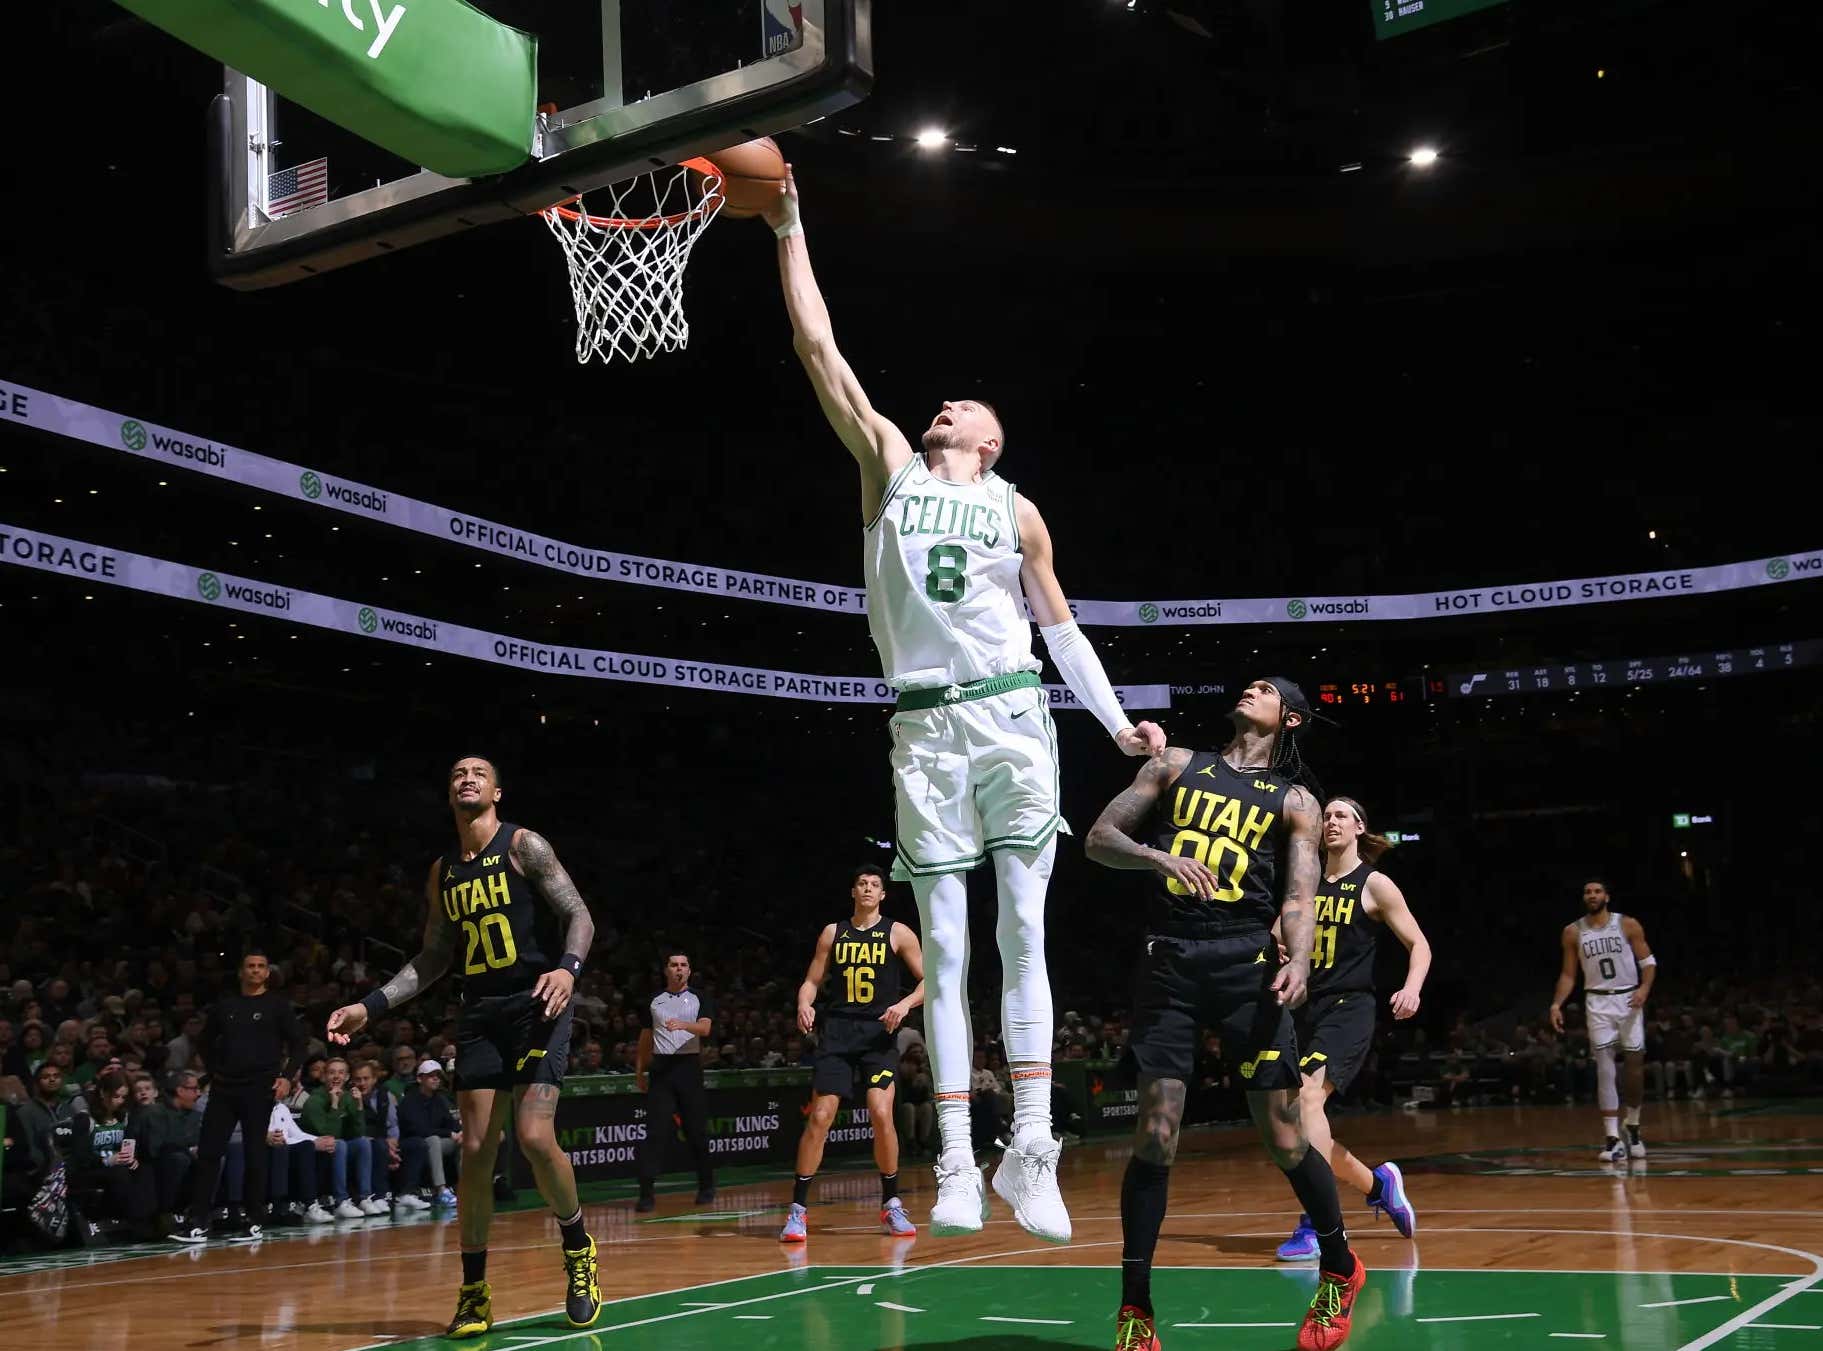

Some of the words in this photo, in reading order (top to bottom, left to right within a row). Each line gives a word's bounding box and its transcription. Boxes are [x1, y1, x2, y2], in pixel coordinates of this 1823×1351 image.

[769, 32, 789, 53] NBA
[152, 433, 225, 468] wasabi
[325, 481, 387, 513] wasabi
[900, 495, 1001, 549] CELTICS
[449, 517, 538, 558] OFFICIAL
[544, 544, 611, 573] CLOUD
[619, 560, 718, 589] STORAGE
[725, 575, 816, 602] PARTNER
[823, 590, 848, 606] OF
[925, 544, 968, 603] 8
[225, 583, 290, 611] wasabi
[1310, 599, 1369, 614] wasabi
[1435, 593, 1482, 612] HOT
[1491, 586, 1572, 606] CLOUD
[1580, 574, 1693, 598] STORAGE
[1162, 603, 1221, 618] wasabi
[381, 614, 437, 641] wasabi
[494, 640, 586, 670] OFFICIAL
[593, 656, 666, 679] CLOUD
[674, 665, 767, 690] STORAGE
[773, 676, 866, 698] PARTNER
[1508, 680, 1520, 690] 31
[1536, 678, 1549, 688] 18
[1568, 675, 1576, 686] 8
[1593, 673, 1606, 683] 12
[1198, 685, 1224, 694] JOHN
[1253, 779, 1278, 793] LVT
[1173, 786, 1275, 851] UTAH
[482, 855, 501, 867] LVT
[443, 871, 512, 922] UTAH
[1340, 882, 1357, 892] LVT
[461, 912, 517, 976] 20
[835, 942, 887, 965] UTAH
[1582, 936, 1622, 960] CELTICS
[1599, 957, 1617, 980] 0
[842, 966, 876, 1004] 16
